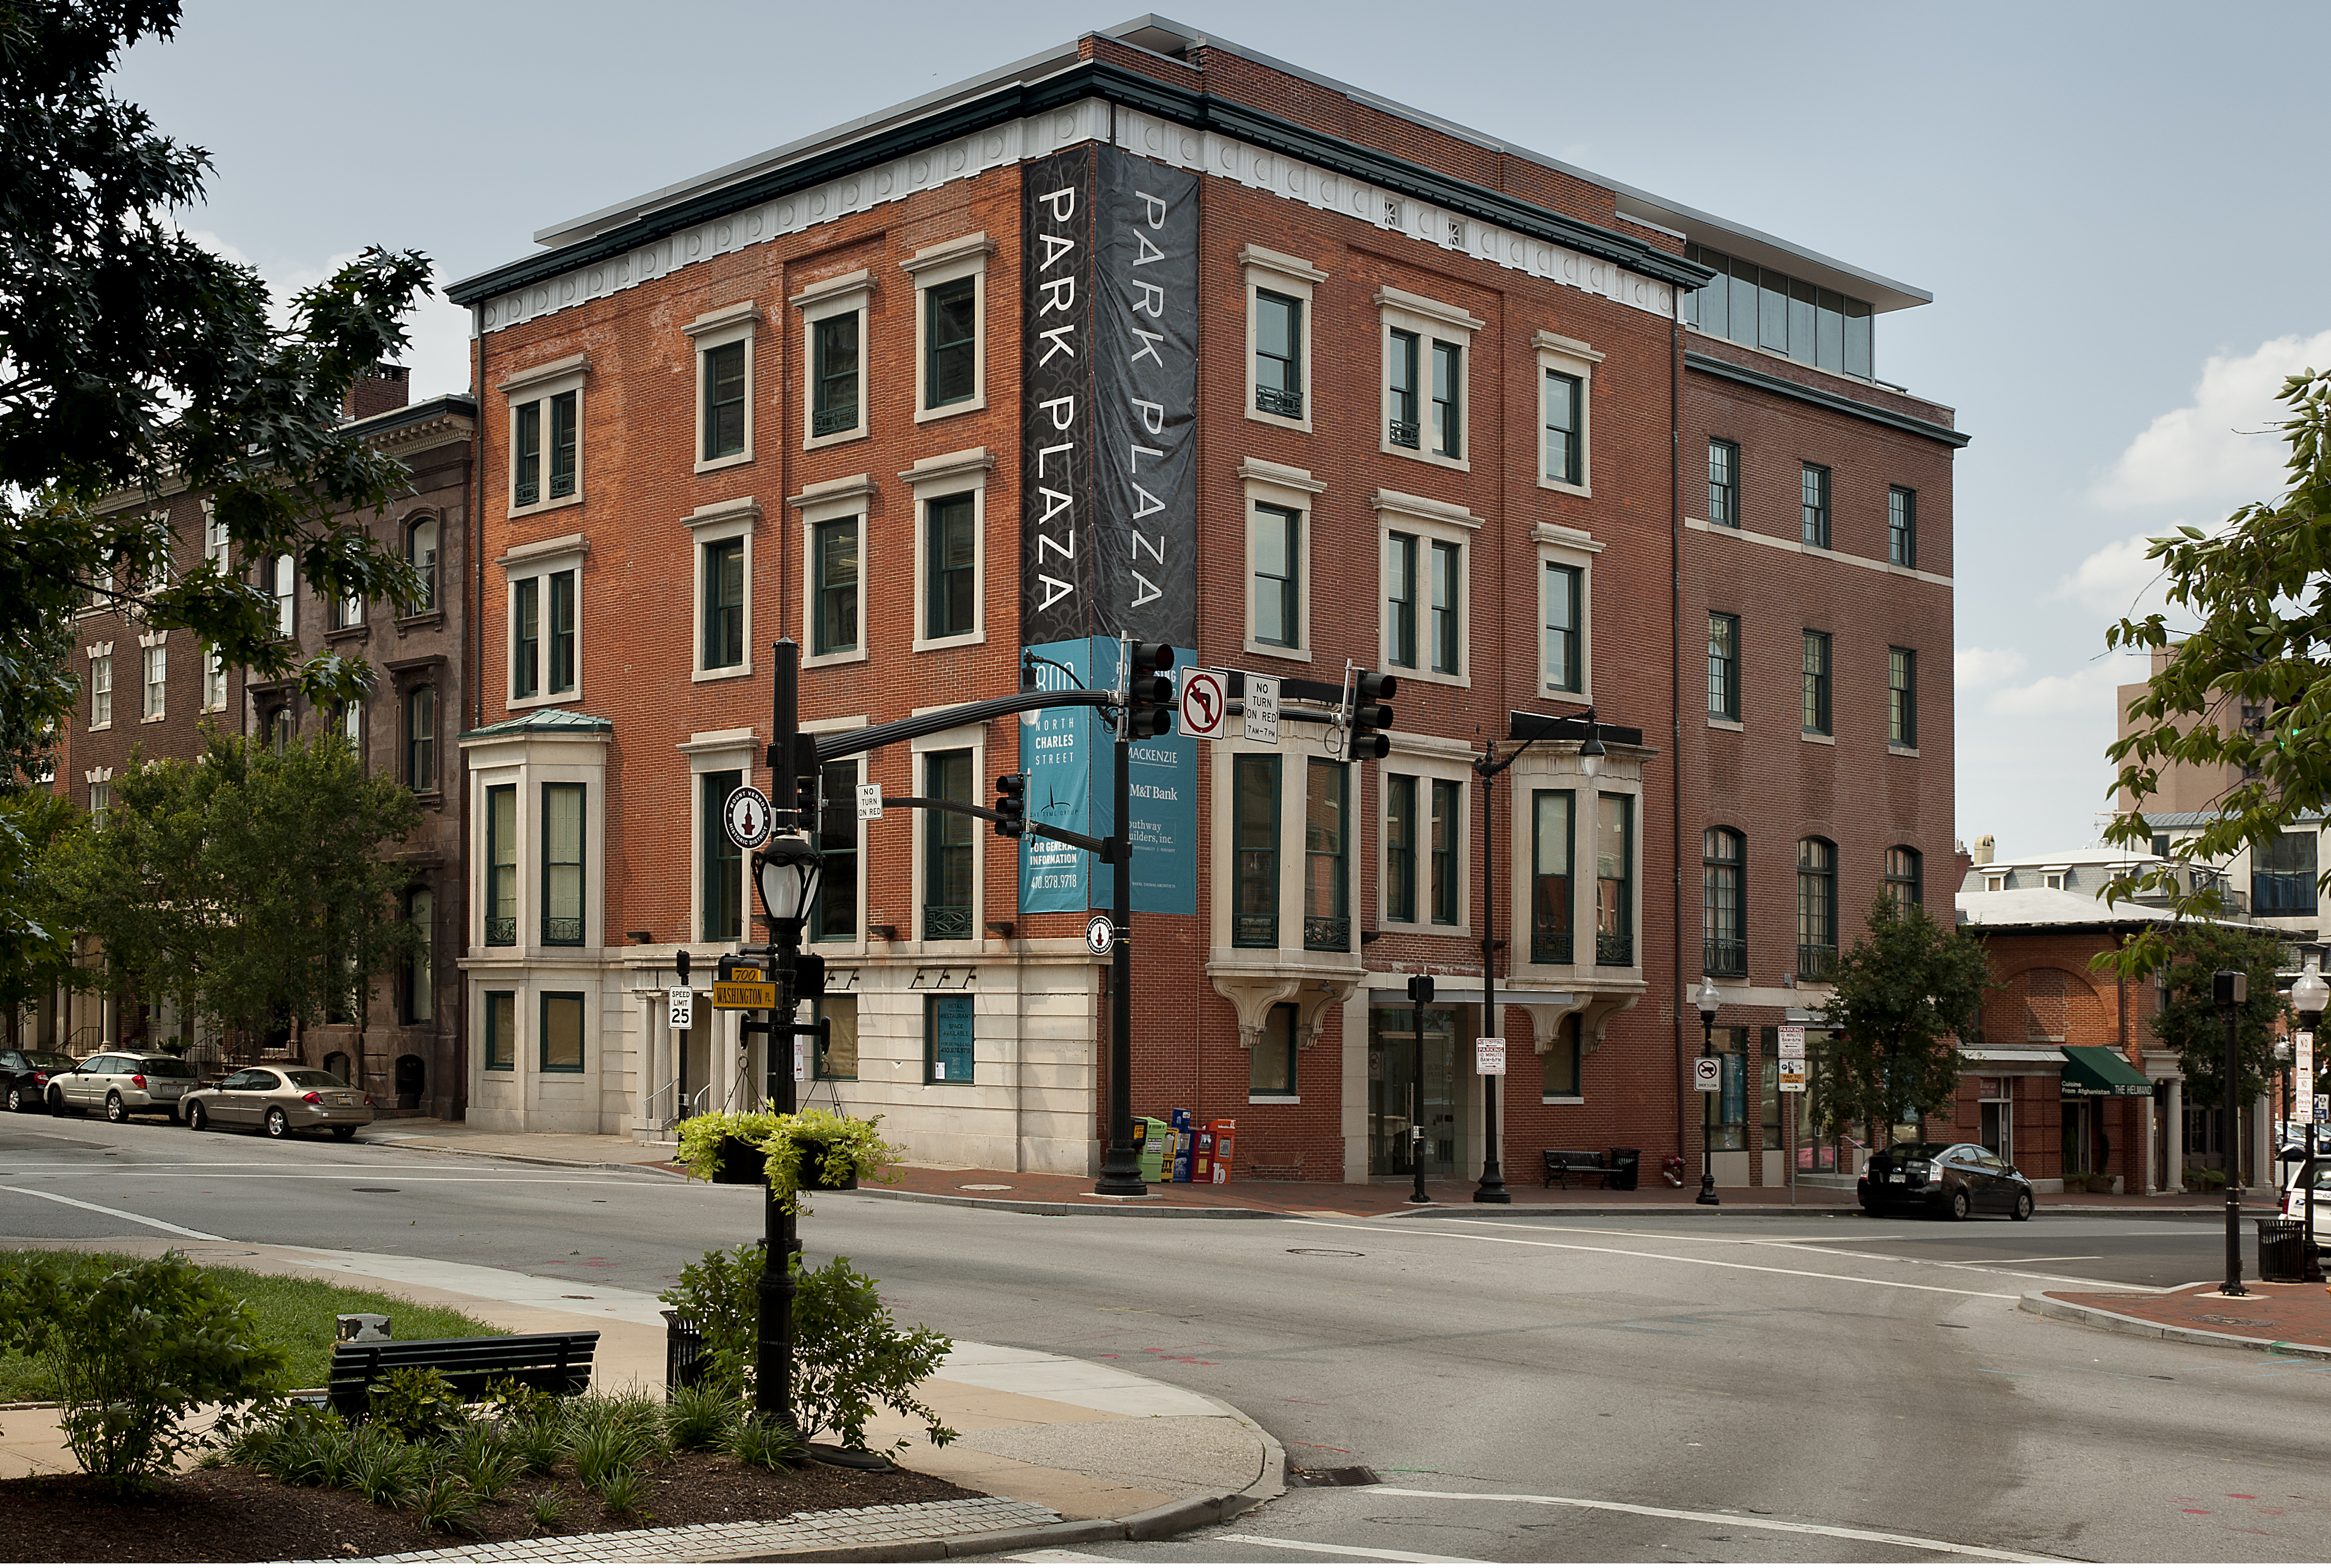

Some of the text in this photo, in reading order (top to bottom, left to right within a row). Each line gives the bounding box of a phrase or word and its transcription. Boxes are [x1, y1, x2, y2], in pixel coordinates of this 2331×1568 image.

[1038, 186, 1075, 612] PARK PLAZA
[1131, 190, 1166, 608] PARK PLAZA
[1036, 662, 1074, 692] 800
[1256, 683, 1268, 694] NO
[1253, 695, 1272, 709] TURN
[1246, 709, 1276, 723] ON RED
[1035, 717, 1074, 731] NORTH
[1035, 734, 1074, 749] CHARLES
[1035, 752, 1074, 765] STREET
[1129, 747, 1177, 764] MACKENZIE
[864, 787, 873, 796] NO
[1130, 783, 1178, 800] M&T Bank
[730, 791, 767, 811] MOUNT VERNON
[862, 798, 877, 806] TURN
[869, 807, 881, 815] RED
[1129, 819, 1162, 833] outhway
[728, 823, 768, 845] HISTORIC DISTRICT
[1129, 831, 1173, 844] uilders, inc.
[1030, 853, 1077, 865] INFORMATION
[1031, 874, 1077, 889] 410.878.9718
[734, 970, 756, 981] 700
[716, 987, 763, 1004] WASHINGTON
[671, 1008, 690, 1023] 25
[2300, 1039, 2308, 1047] NO
[2115, 1085, 2152, 1095] THE HELMAND
[1162, 1160, 1173, 1168] ITY
